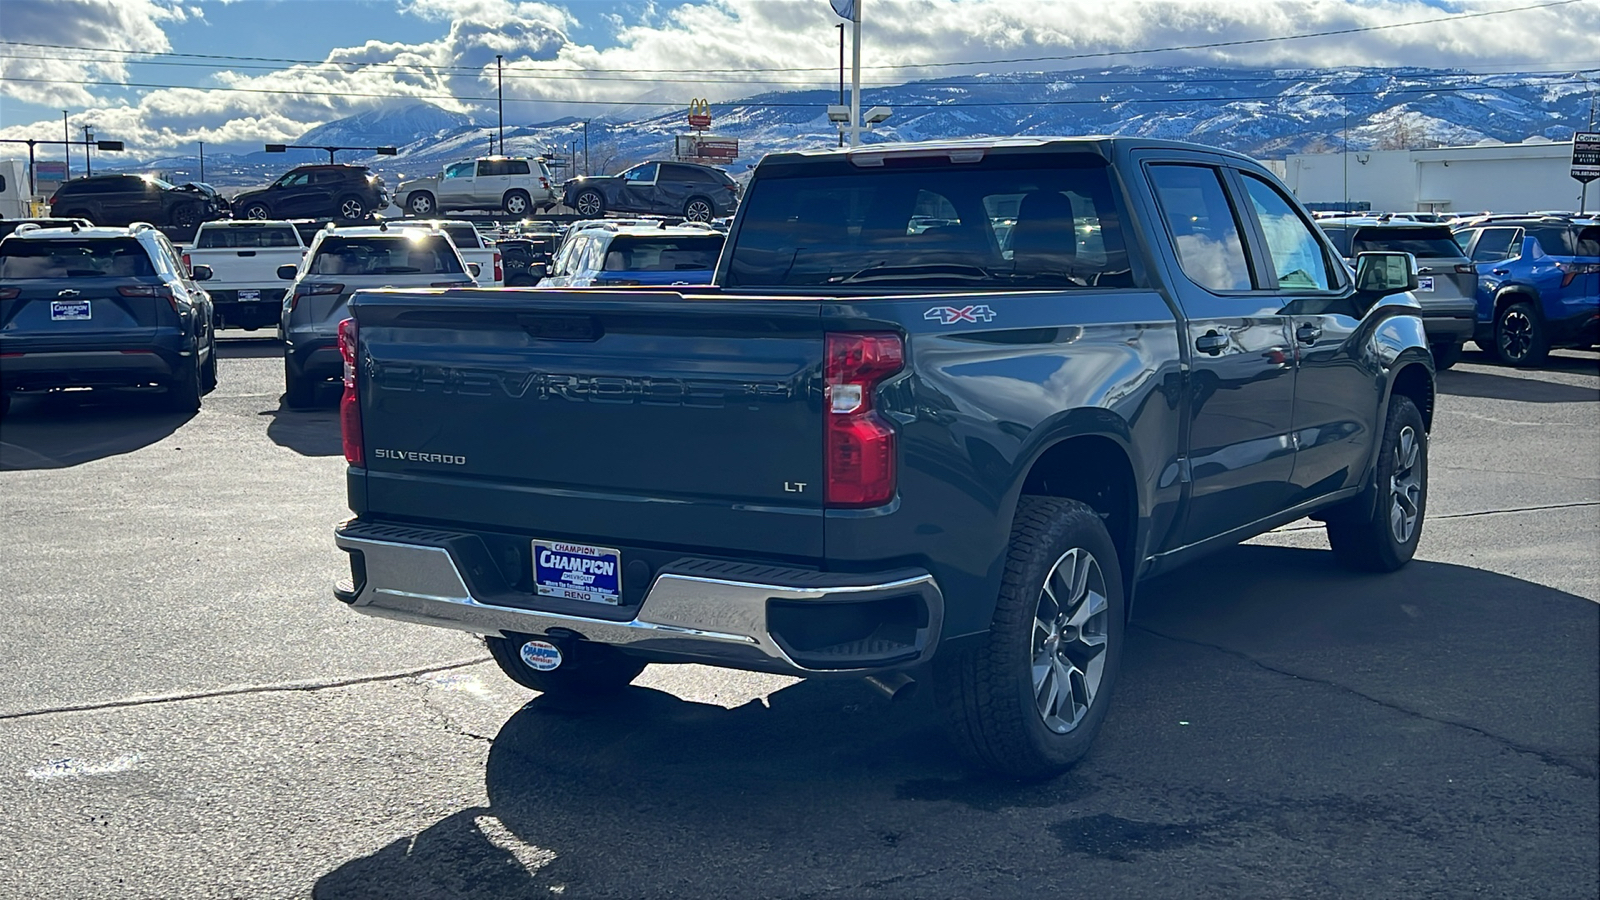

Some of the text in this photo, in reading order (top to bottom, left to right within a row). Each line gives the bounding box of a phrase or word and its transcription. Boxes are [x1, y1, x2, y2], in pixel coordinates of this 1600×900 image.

[375, 449, 466, 465] SILVERADO
[784, 482, 807, 493] LT
[554, 544, 596, 555] CHAMPION
[540, 550, 615, 576] CHAMPION
[563, 573, 593, 582] CHEVROLET
[564, 591, 591, 600] RENO
